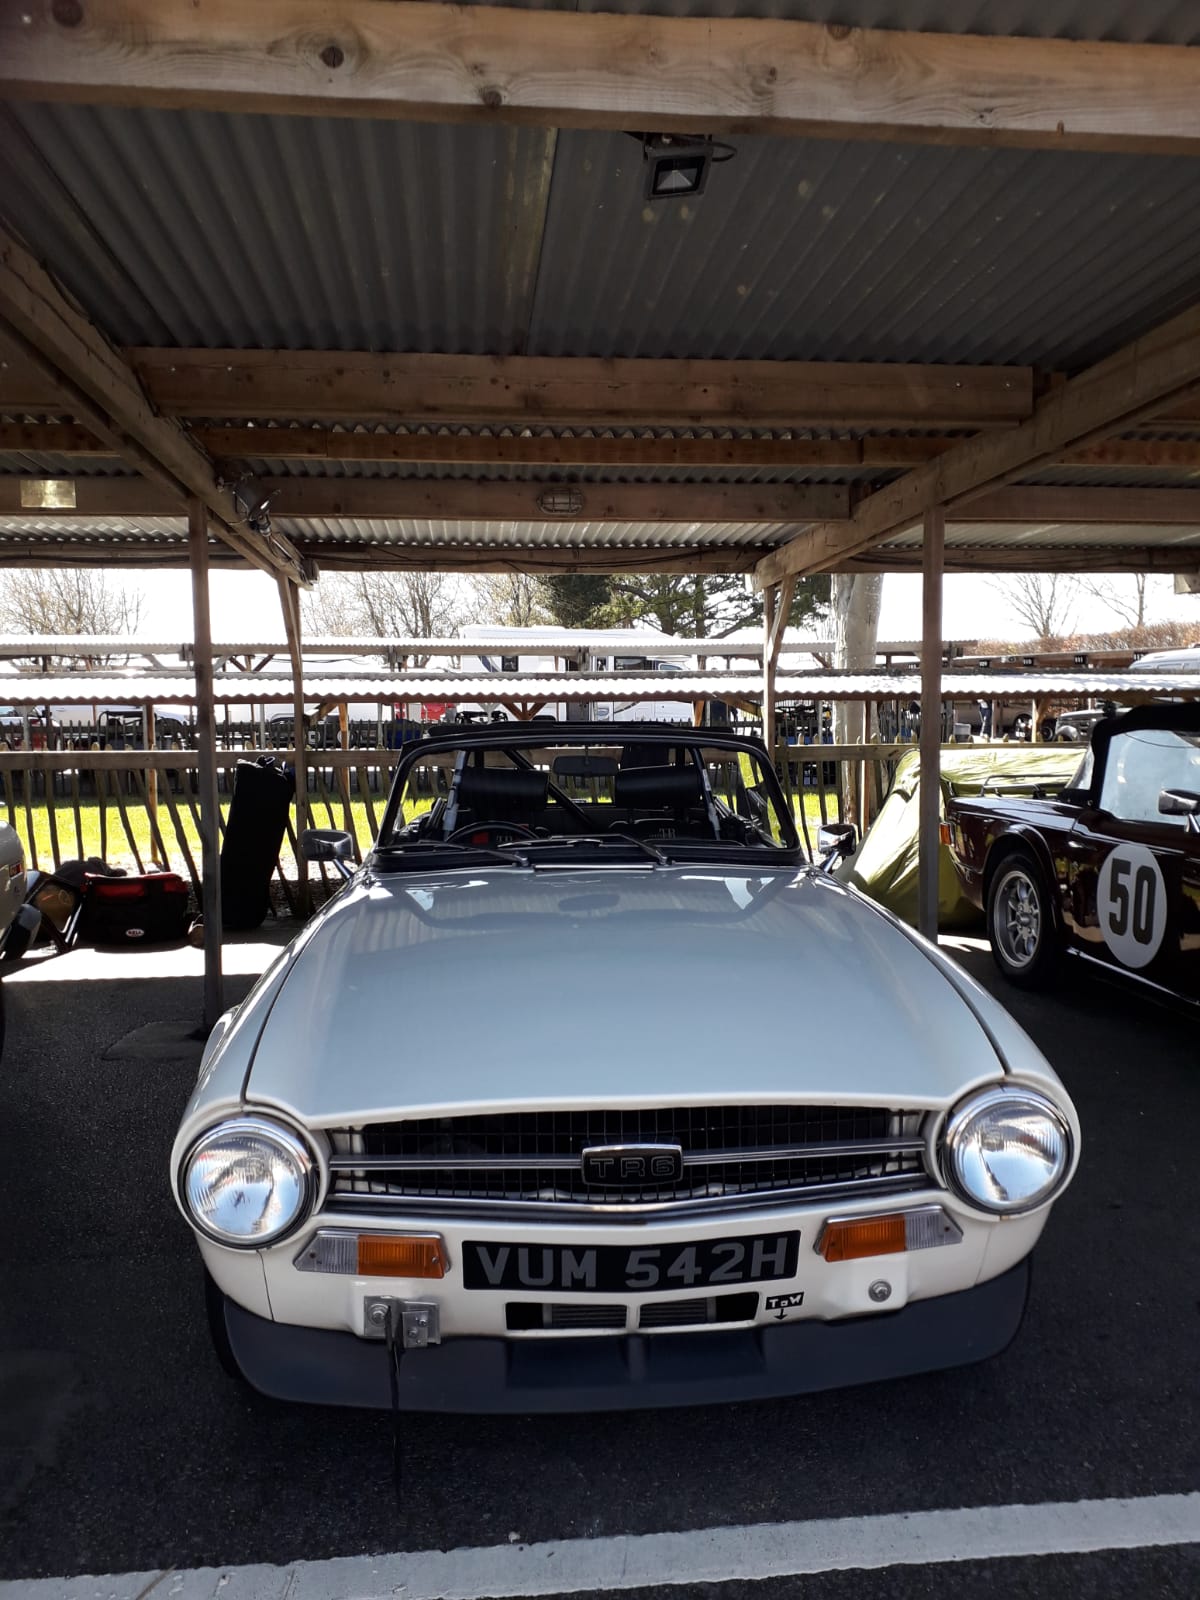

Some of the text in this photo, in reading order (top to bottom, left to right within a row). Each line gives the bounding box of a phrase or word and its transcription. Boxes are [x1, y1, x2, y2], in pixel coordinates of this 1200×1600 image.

[1109, 857, 1156, 945] 50
[590, 1155, 675, 1178] TR6
[476, 1237, 788, 1289] VUM 542H
